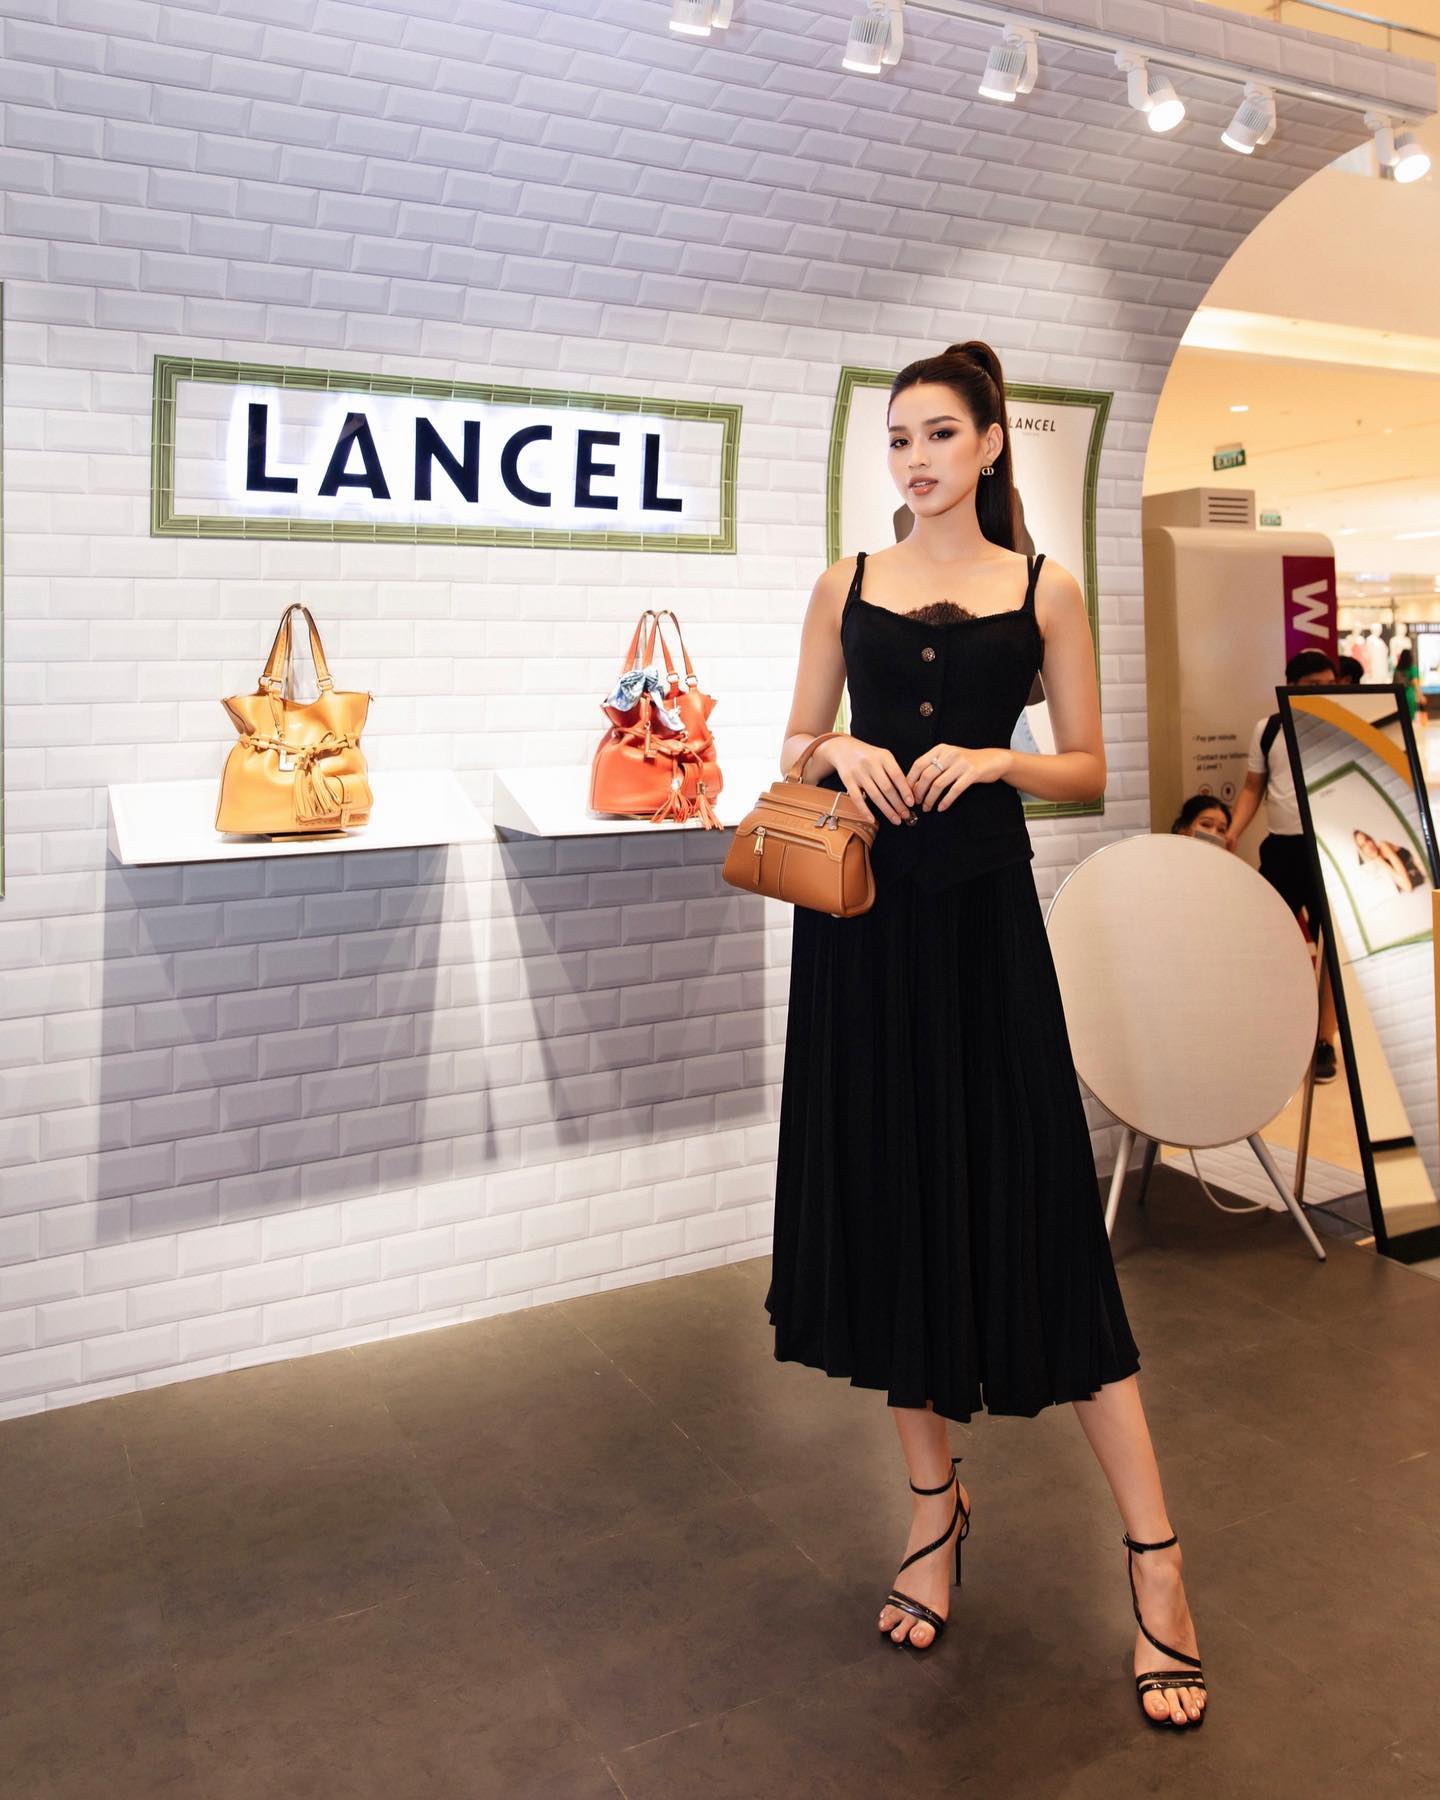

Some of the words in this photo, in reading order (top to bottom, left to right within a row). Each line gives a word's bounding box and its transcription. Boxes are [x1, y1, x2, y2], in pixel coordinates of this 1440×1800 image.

[246, 403, 682, 512] LANCEL
[1009, 417, 1056, 432] LANCEL
[1291, 579, 1330, 657] W
